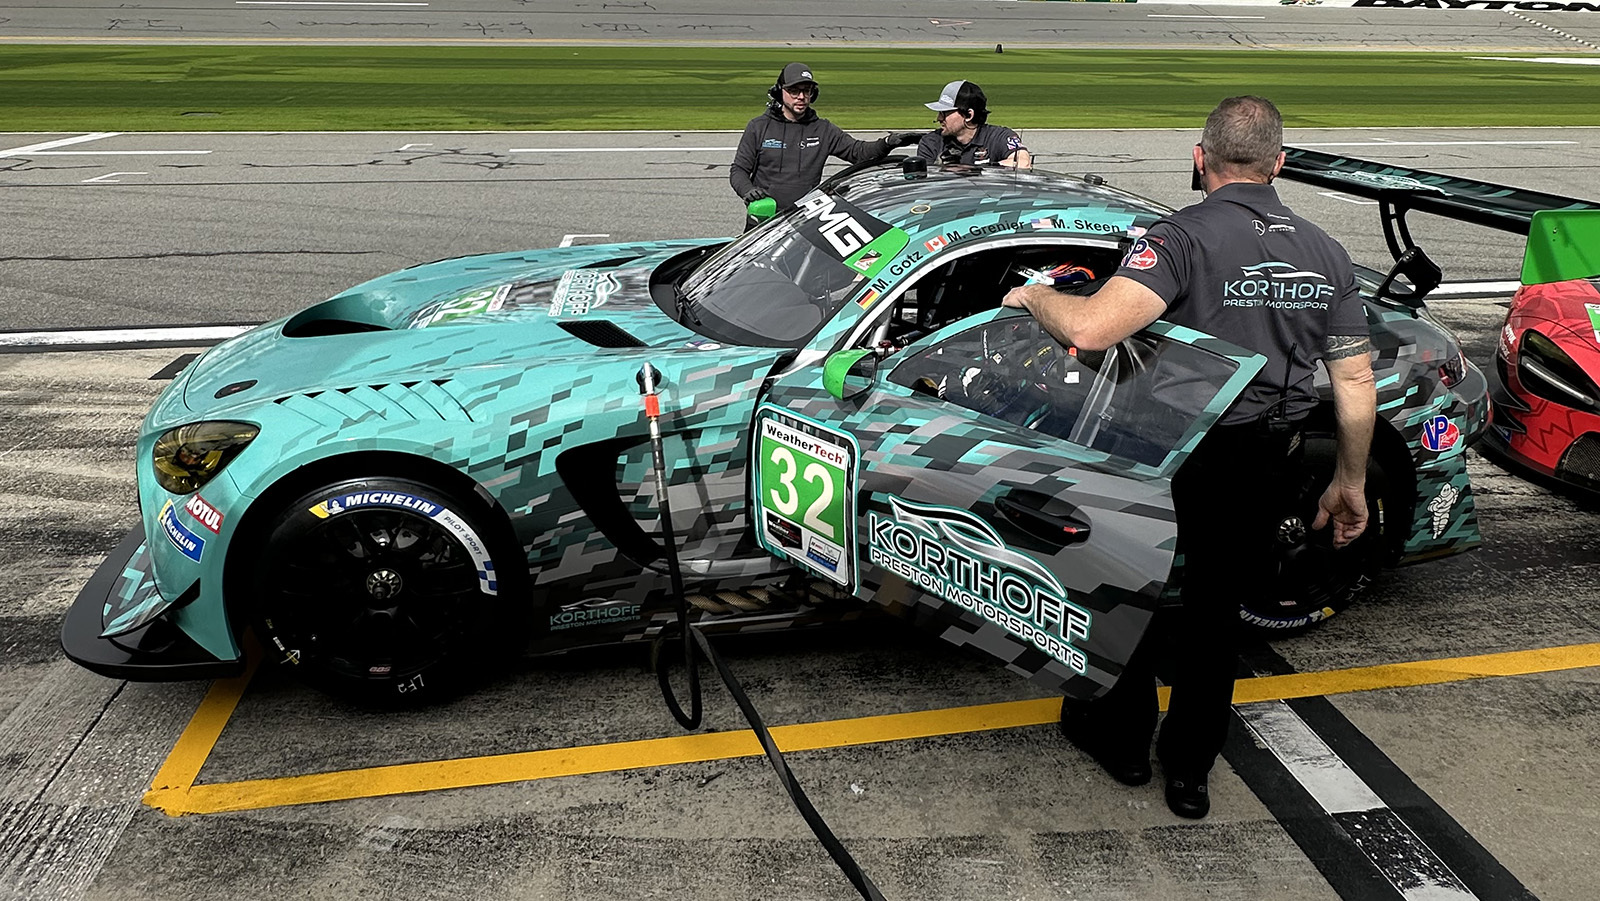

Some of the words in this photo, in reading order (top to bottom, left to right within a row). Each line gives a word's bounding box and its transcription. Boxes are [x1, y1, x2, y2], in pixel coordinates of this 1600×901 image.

[794, 189, 874, 258] AMG
[946, 230, 966, 243] M.
[969, 220, 1025, 236] Grenier
[1053, 218, 1070, 229] M.
[1074, 219, 1120, 233] Skeen
[871, 278, 892, 293] M.
[890, 251, 924, 276] Gotz
[1223, 298, 1264, 307] PRESTN
[766, 424, 844, 465] WeatherTech
[1423, 415, 1449, 450] VP
[345, 493, 436, 514] MICHELIN
[770, 446, 835, 539] 32
[186, 494, 220, 531] MOTUL
[166, 517, 197, 552] MICHELIN
[443, 516, 466, 534] PILOT
[462, 533, 483, 556] SPORT
[869, 512, 1089, 642] KORTHOFF
[549, 605, 641, 625] KORTHOFF
[871, 547, 944, 595] PRESTON
[946, 584, 1085, 674] MOTORSPORTS
[1240, 609, 1308, 629] MICHELIN
